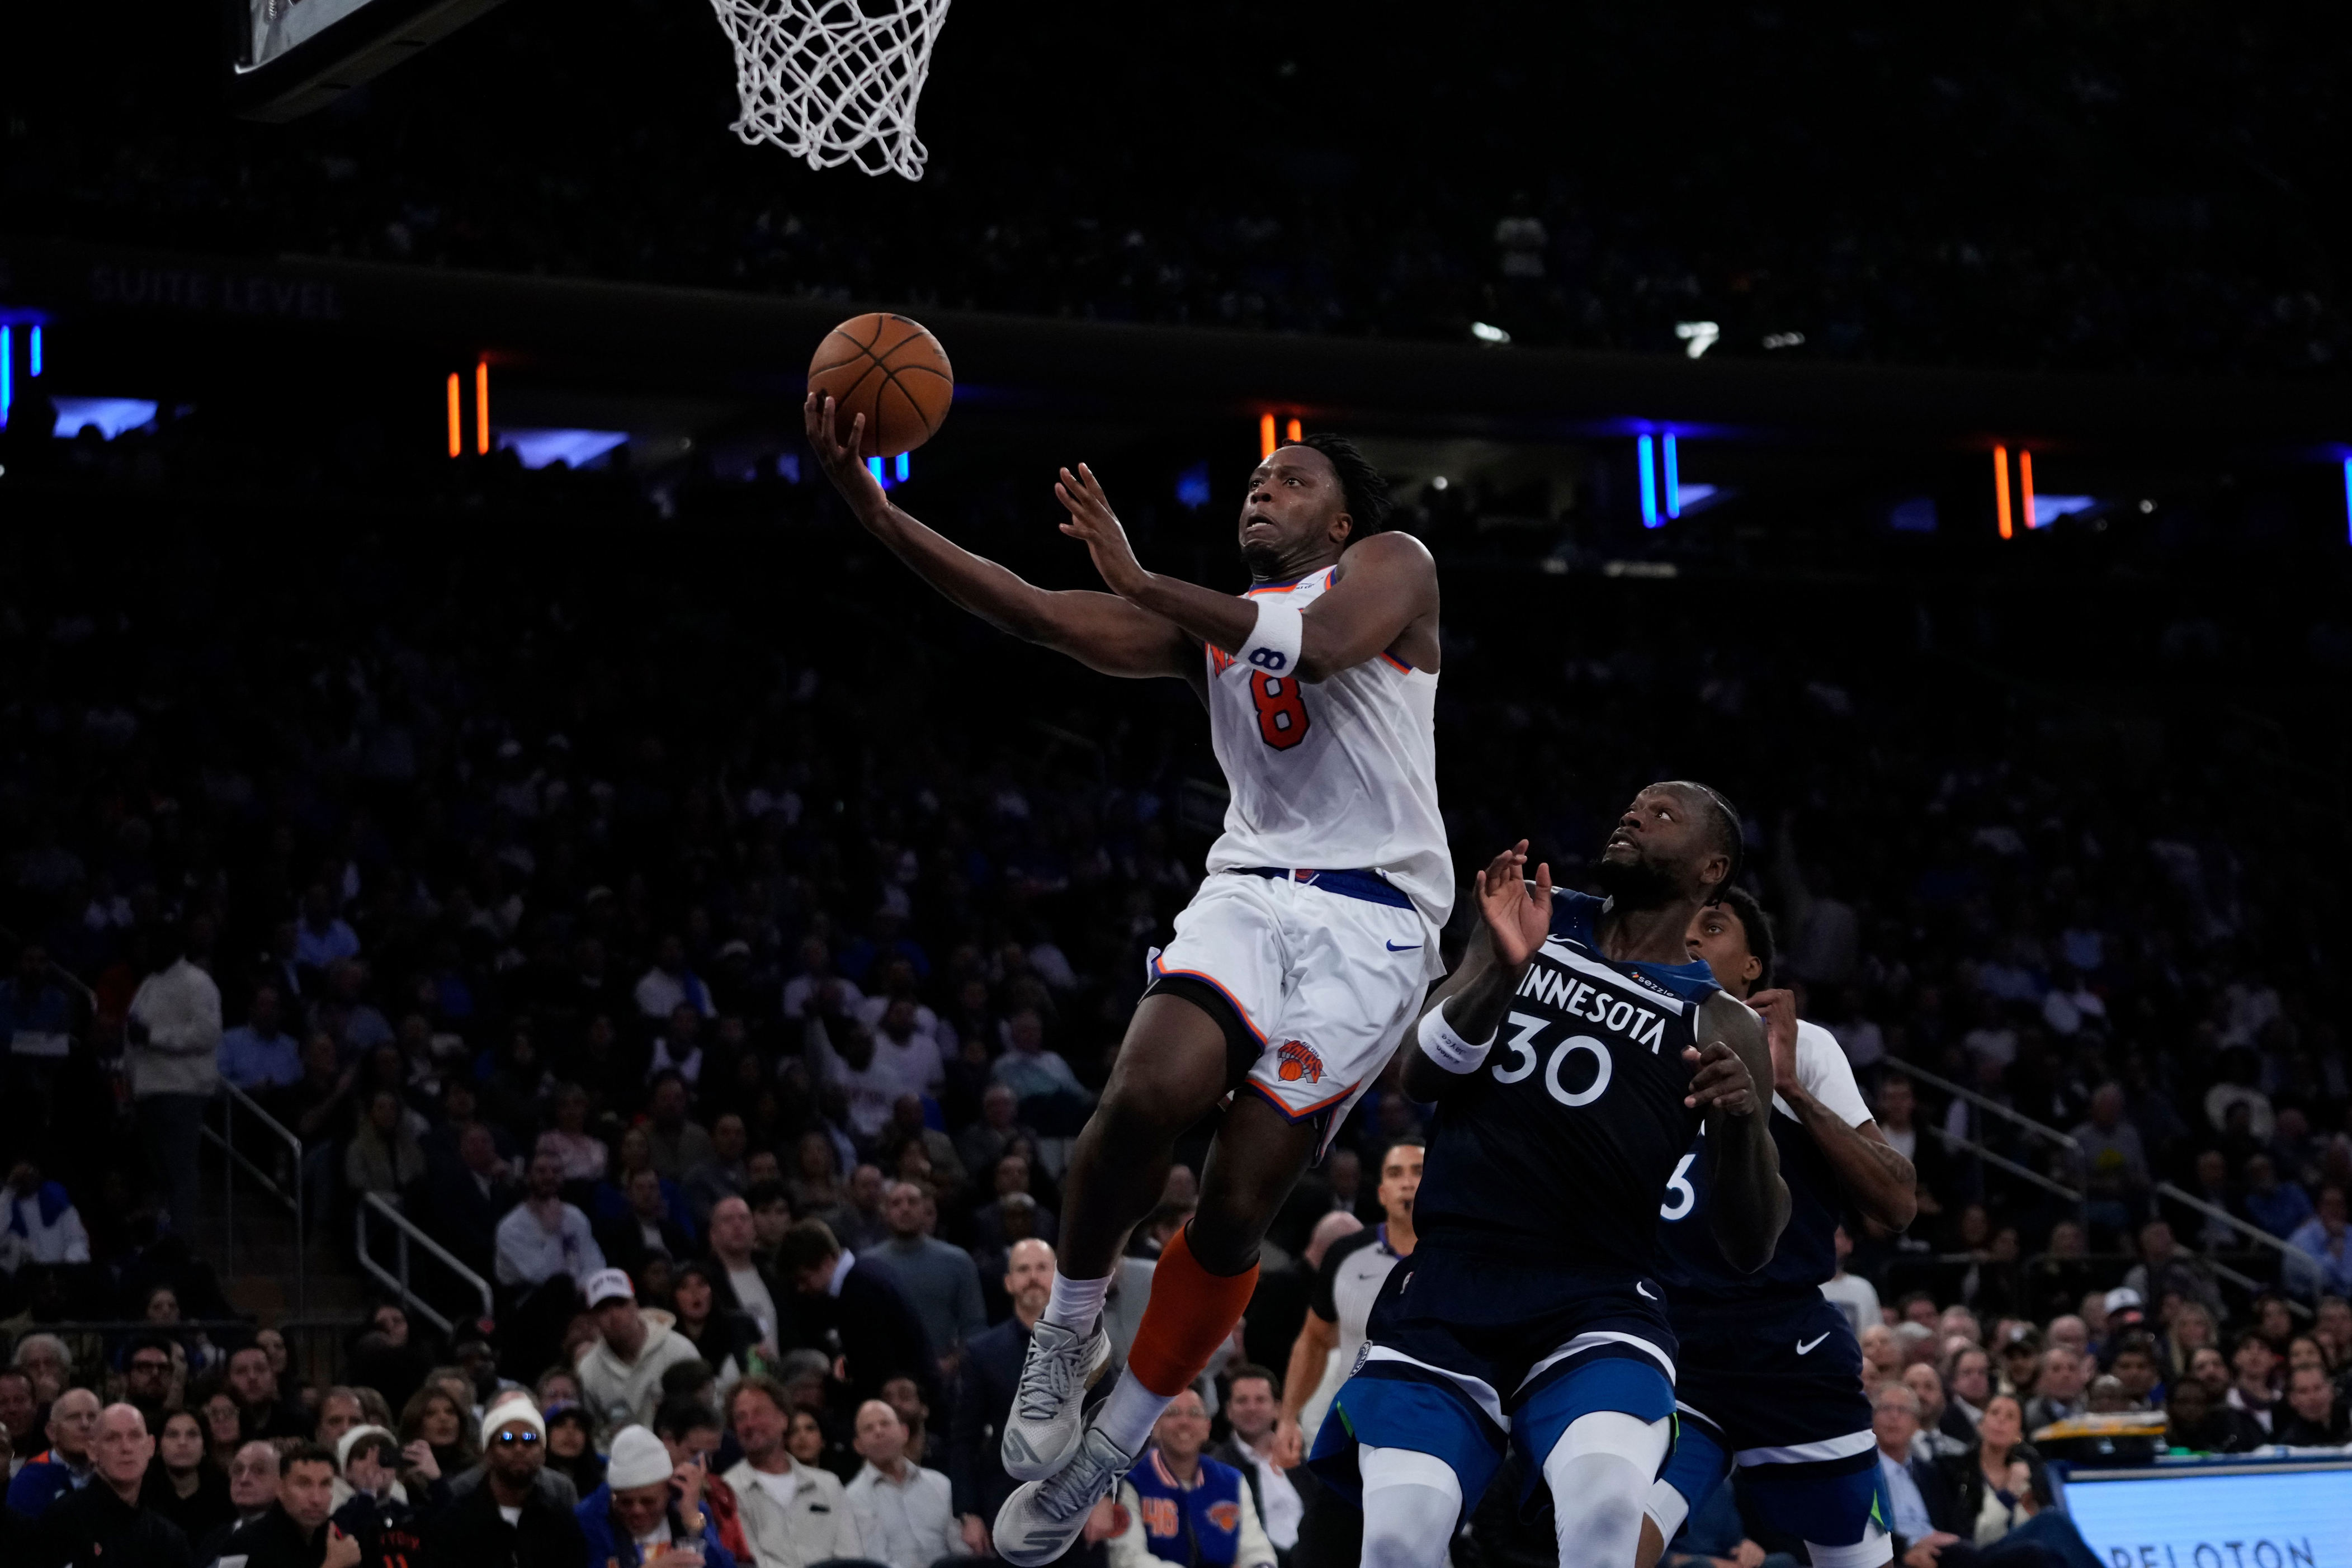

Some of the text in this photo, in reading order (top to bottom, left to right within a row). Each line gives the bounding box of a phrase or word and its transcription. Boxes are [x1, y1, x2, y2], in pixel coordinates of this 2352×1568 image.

[89, 264, 341, 320] SUITE LEVEL
[1248, 648, 1286, 670] 8
[1249, 669, 1311, 752] 8
[1515, 962, 1666, 1055] INNESOTA
[1638, 976, 1674, 997] sezzle
[1491, 1010, 1612, 1107] 30
